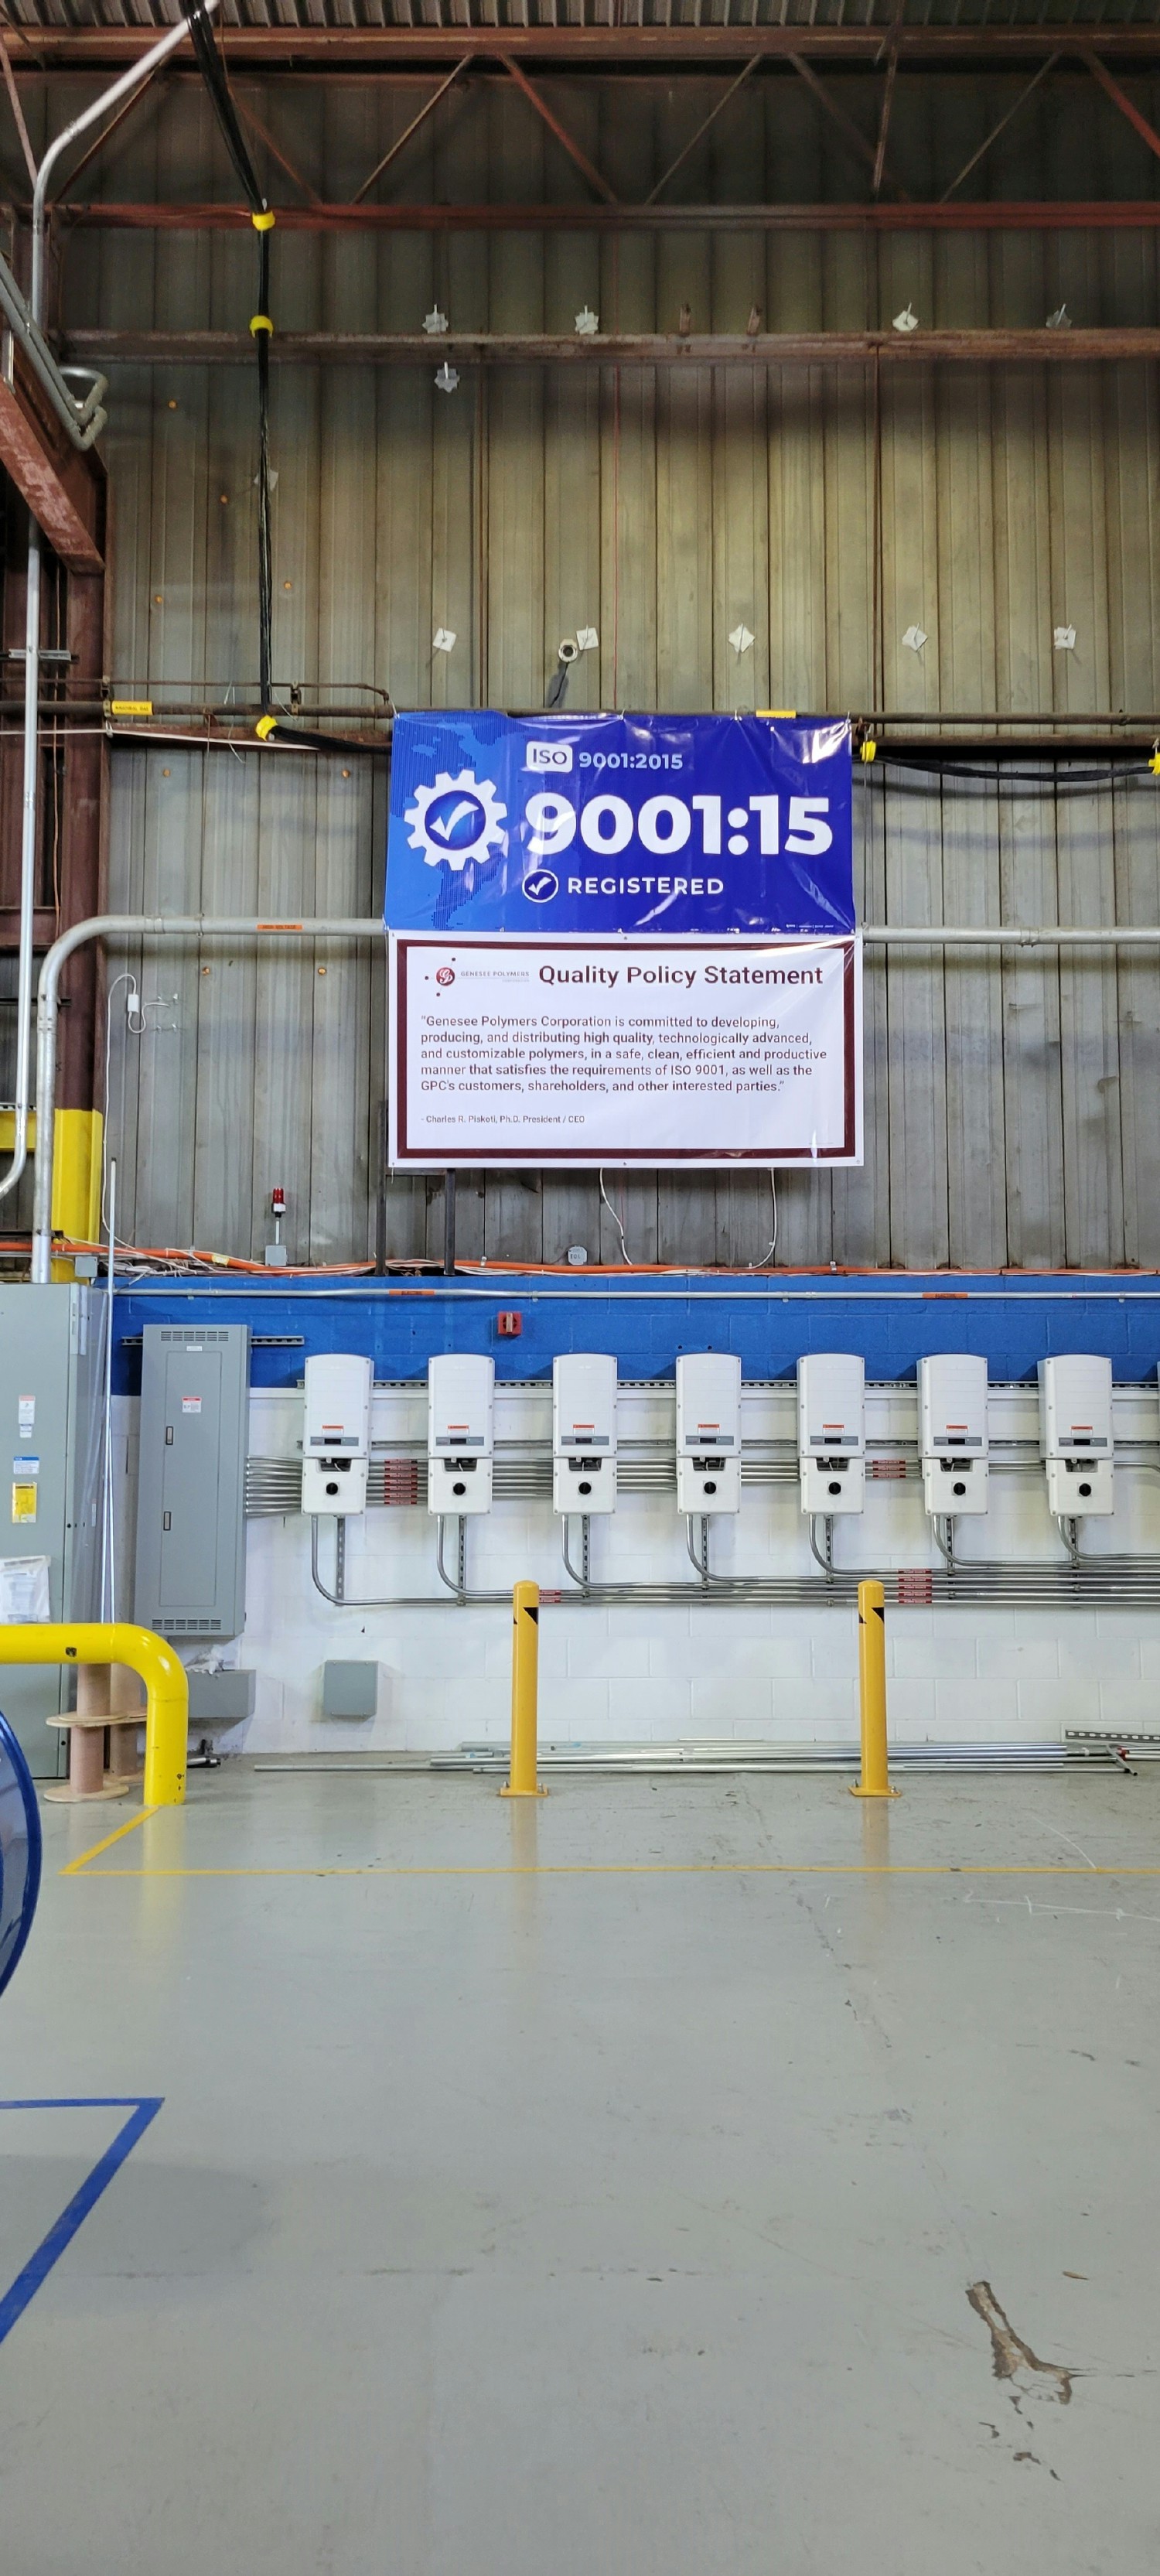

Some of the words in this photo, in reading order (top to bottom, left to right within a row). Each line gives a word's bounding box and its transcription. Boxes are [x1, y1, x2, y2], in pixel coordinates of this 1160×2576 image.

[533, 748, 568, 764] ISO
[579, 752, 683, 770] 9001:2015
[525, 792, 834, 856] 9001:15
[568, 876, 725, 895] REGISTERED
[539, 965, 619, 987] Quality
[627, 965, 697, 988] Policy
[705, 965, 824, 984] Statement
[482, 1016, 537, 1029] Polymers
[541, 1016, 612, 1029] Corporation
[616, 1016, 625, 1027] is
[629, 1016, 693, 1028] committed
[696, 1017, 708, 1028] to
[711, 1016, 780, 1030] developing,
[421, 1031, 483, 1045] producing,
[487, 1031, 508, 1043] and
[513, 1031, 580, 1045] distributing
[584, 1031, 609, 1045] high
[613, 1032, 655, 1046] quality,
[658, 1032, 749, 1046] technologically
[752, 1032, 812, 1046] advanced,
[421, 1047, 442, 1059] and
[446, 1047, 526, 1059] customizable
[529, 1047, 588, 1061] polymers,
[592, 1047, 602, 1059] in
[606, 1051, 612, 1059] a
[616, 1048, 644, 1061] safe,
[648, 1048, 683, 1061] clean,
[686, 1048, 735, 1060] efficient
[739, 1048, 761, 1060] and
[764, 1048, 827, 1062] productive
[421, 1066, 466, 1075] manner
[469, 1064, 493, 1075] that
[496, 1064, 547, 1075] satisfies
[550, 1064, 569, 1075] the
[573, 1064, 652, 1078] requirements
[655, 1064, 667, 1075] of
[671, 1064, 691, 1075] ISO
[695, 1064, 728, 1077] 9001,
[732, 1067, 746, 1076] as
[749, 1064, 773, 1075] well
[776, 1067, 790, 1076] as
[793, 1064, 813, 1076] the
[459, 1081, 525, 1093] customers,
[528, 1080, 609, 1093] shareholders,
[612, 1080, 634, 1092] and
[638, 1080, 669, 1092] other
[673, 1080, 732, 1092] interested
[426, 1115, 455, 1123] Charles
[458, 1115, 466, 1123] R.
[500, 1115, 520, 1123] Ph.D.
[523, 1115, 561, 1123] President
[568, 1115, 585, 1123] CEO
